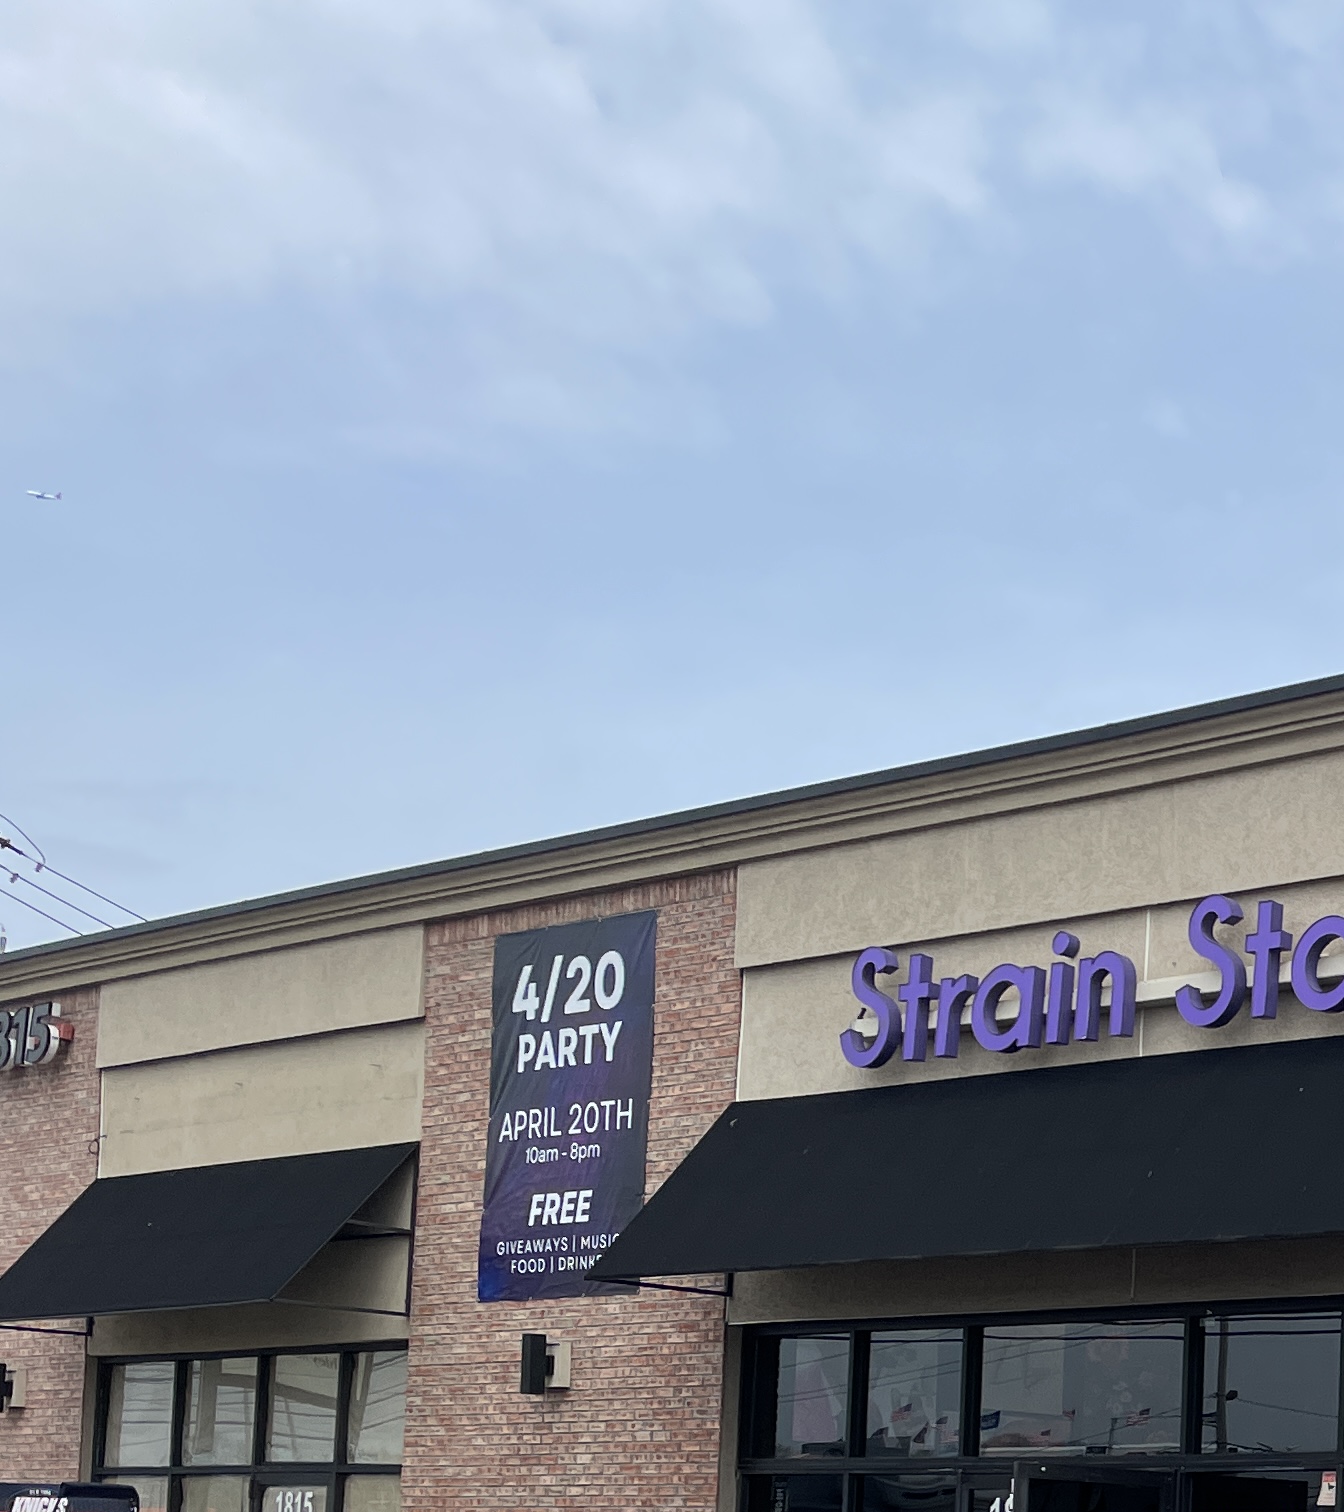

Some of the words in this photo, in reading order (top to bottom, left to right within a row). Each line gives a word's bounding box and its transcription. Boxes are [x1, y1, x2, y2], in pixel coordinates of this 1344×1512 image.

[512, 950, 625, 1023] 4/20
[839, 931, 1137, 1069] Strain
[517, 1020, 623, 1073] PARTY
[499, 1107, 562, 1143] APRIL
[568, 1098, 633, 1135] 20TH
[525, 1146, 559, 1164] 10am
[570, 1142, 600, 1164] 8pm
[527, 1189, 593, 1227] FREE
[496, 1236, 568, 1256] GIVEAWAYS
[510, 1259, 546, 1274] FOOD
